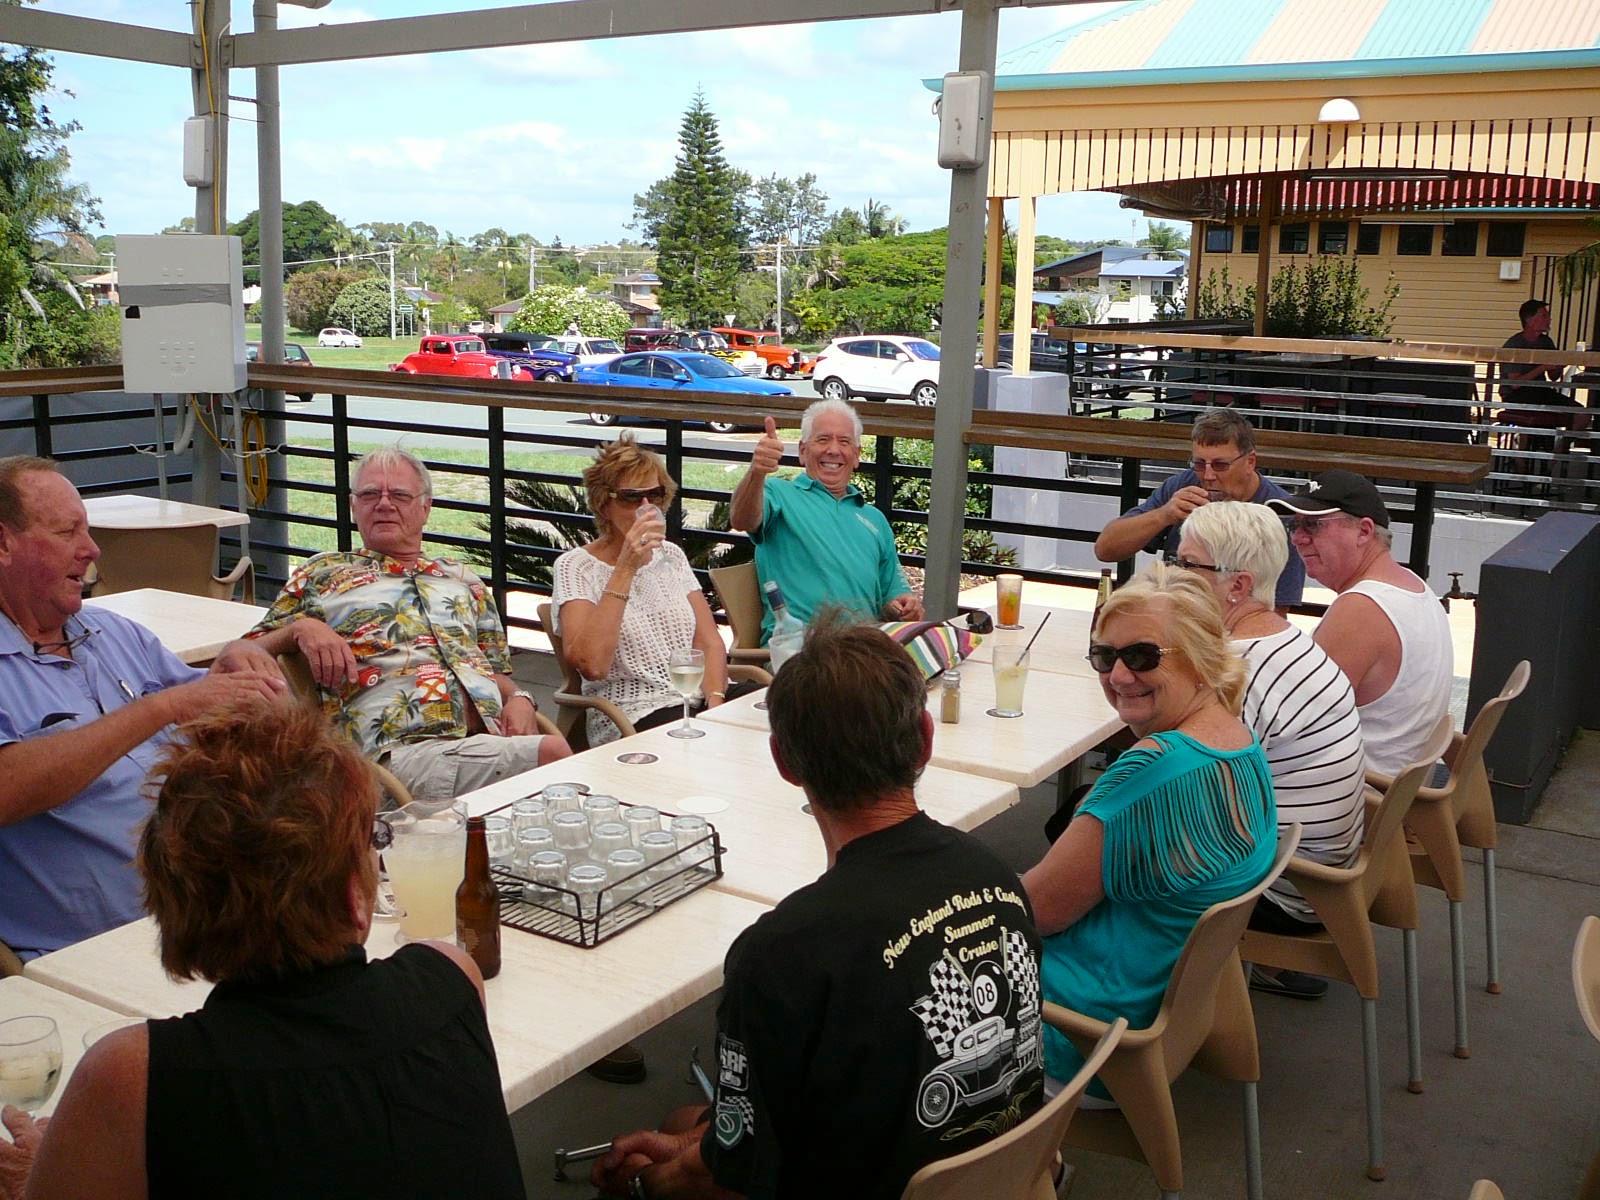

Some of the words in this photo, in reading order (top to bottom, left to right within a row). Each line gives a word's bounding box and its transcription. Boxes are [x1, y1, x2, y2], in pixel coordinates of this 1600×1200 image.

[883, 932, 911, 969] New
[910, 900, 954, 937] England
[952, 890, 983, 912] Rods
[982, 888, 994, 903] &
[944, 914, 996, 944] Summer
[958, 940, 999, 963] Cruise
[976, 982, 995, 1006] 08
